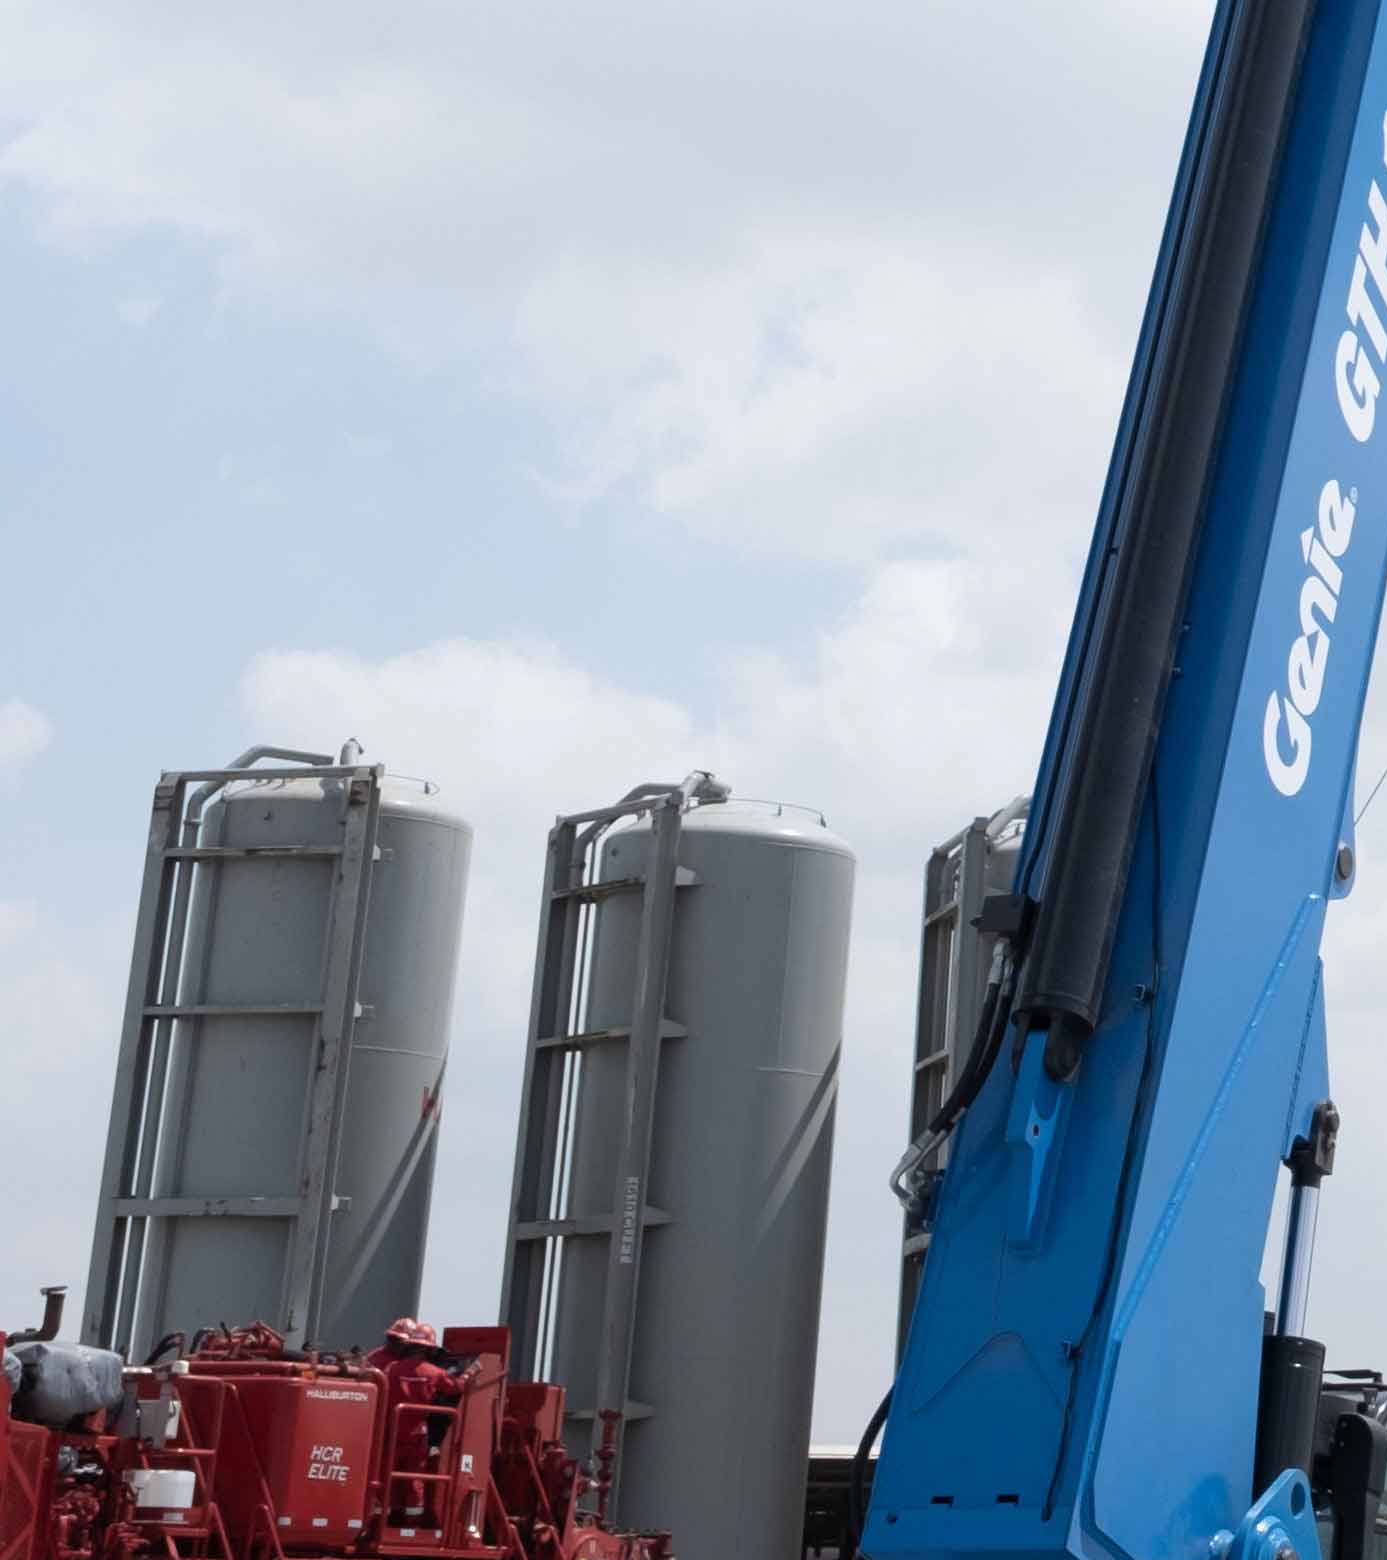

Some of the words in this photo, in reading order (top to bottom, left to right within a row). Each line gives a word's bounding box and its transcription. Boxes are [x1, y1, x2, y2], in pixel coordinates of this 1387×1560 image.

[1263, 479, 1356, 797] Genie
[306, 1390, 369, 1402] HALLIBURTON
[310, 1445, 344, 1462] HCR
[307, 1463, 350, 1482] ELITE
